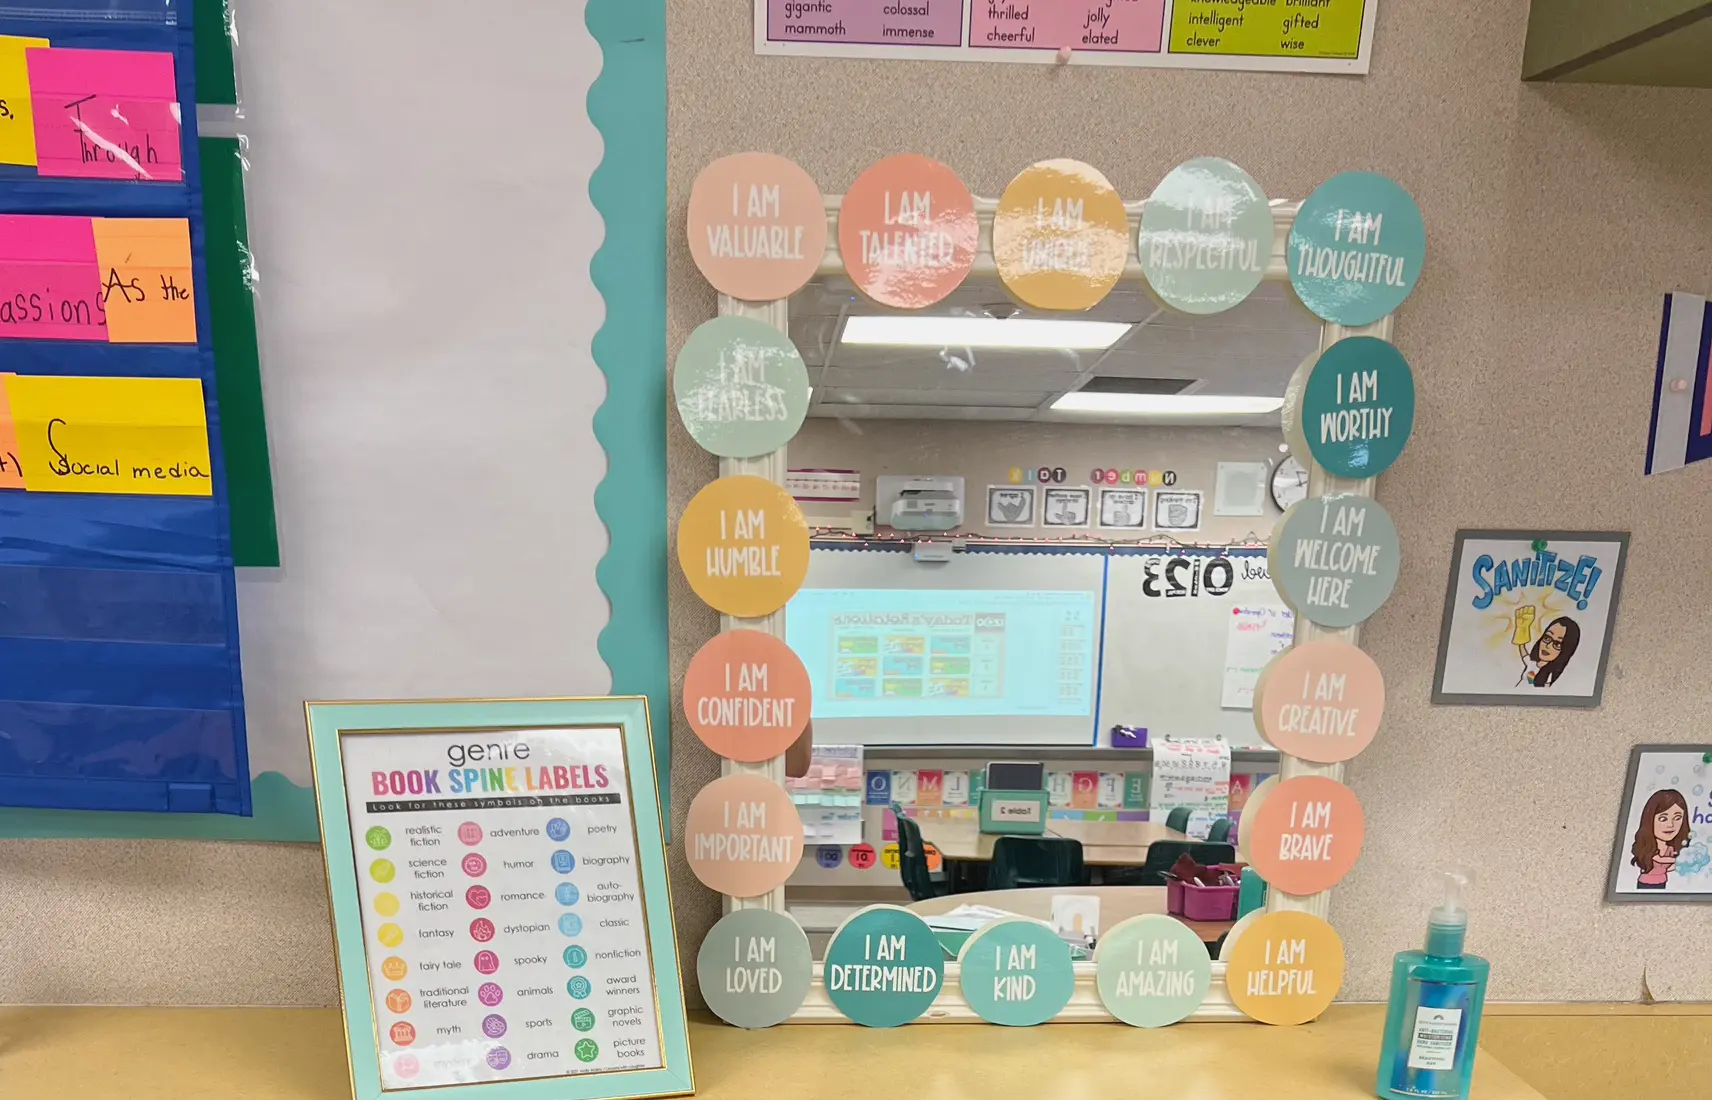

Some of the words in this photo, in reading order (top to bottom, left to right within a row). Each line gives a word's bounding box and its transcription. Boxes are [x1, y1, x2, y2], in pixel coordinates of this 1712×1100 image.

[785, 1, 832, 19] gigantic
[883, 4, 929, 16] colossal
[988, 5, 1028, 20] thrilled
[1084, 9, 1110, 28] jolly
[1188, 12, 1244, 31] intelligent
[1282, 12, 1319, 35] gifted
[785, 20, 846, 36] mammoth
[882, 25, 934, 39] immense
[987, 28, 1034, 43] cheerful
[1082, 30, 1118, 44] elated
[1186, 36, 1220, 47] clever
[1280, 39, 1304, 49] wise
[732, 183, 738, 216] I
[747, 185, 779, 217] AM
[885, 191, 890, 225] I
[898, 191, 931, 225] AM
[1334, 209, 1341, 241] I
[1350, 212, 1382, 246] AM
[707, 225, 804, 259] VALUABLE
[860, 230, 955, 266] TALENTED
[1298, 246, 1405, 287] THOUGHTFUL
[102, 268, 145, 303] As
[161, 275, 189, 301] the
[1336, 374, 1341, 404] I
[1349, 370, 1378, 402] AM
[1320, 408, 1393, 444] WORTHY
[133, 462, 210, 479] media
[721, 510, 726, 540] I
[735, 509, 764, 540] AM
[1321, 505, 1329, 533] I
[1333, 506, 1366, 536] AM
[706, 546, 781, 577] HUMBLE
[1294, 539, 1381, 576] WELCOME
[1472, 550, 1602, 610] SANITIZE!
[1307, 576, 1353, 609] HERE
[725, 663, 730, 692] I
[739, 663, 767, 692] AM
[1302, 672, 1310, 700] I
[1315, 673, 1346, 701] AM
[697, 697, 795, 727] CONFIDENT
[1278, 704, 1359, 736] CREATIVE
[447, 743, 530, 767] genre
[371, 769, 442, 796] BOOK
[448, 766, 519, 794] SPINE
[525, 764, 609, 791] LABELS
[373, 803, 401, 811] Look
[474, 798, 522, 808] symbols
[576, 796, 610, 804] books
[724, 801, 729, 828] I
[737, 802, 766, 829] AM
[1290, 802, 1296, 827] I
[1301, 801, 1331, 828] AM
[405, 825, 442, 835] realistic
[490, 827, 539, 838] adventure
[588, 823, 617, 834] poetry
[410, 837, 440, 847] fiction
[694, 833, 794, 864] IMPORTANT
[1279, 833, 1332, 861] BRAVE
[408, 858, 447, 868] science
[503, 859, 534, 869] humor
[582, 854, 630, 866] biography
[414, 869, 444, 879] fiction
[410, 889, 453, 900] historical
[597, 882, 622, 891] auto-
[501, 891, 544, 901] romance
[587, 891, 634, 903] biography
[418, 902, 448, 912] fiction
[504, 922, 550, 934] dystopian
[599, 917, 629, 927] classic
[418, 928, 454, 939] fantasy
[595, 948, 641, 959] nonfiction
[735, 937, 739, 962] I
[747, 937, 775, 963] AM
[865, 934, 870, 960] I
[877, 935, 905, 960] AM
[1138, 940, 1143, 965] I
[1150, 939, 1178, 965] AM
[1265, 939, 1271, 965] I
[1276, 939, 1306, 964] AM
[419, 960, 439, 971] fairy
[442, 960, 461, 969] tale
[514, 955, 548, 966] spooky
[995, 946, 1000, 971] I
[1008, 944, 1036, 970] AM
[606, 975, 636, 984] award
[726, 967, 782, 993] LOVED
[831, 964, 936, 992] DETERMINED
[1116, 971, 1194, 997] AMAZING
[1247, 971, 1317, 996] HELPFUL
[420, 986, 469, 997] traditional
[517, 986, 553, 996] animals
[606, 986, 640, 995] winners
[993, 975, 1036, 1001] KIND
[423, 998, 467, 1009] literature
[608, 1005, 643, 1017] graphic
[436, 1024, 461, 1035] myth
[525, 1018, 552, 1028] sports
[612, 1017, 642, 1027] novels
[613, 1037, 645, 1048] picture
[527, 1050, 559, 1059] drama
[617, 1048, 644, 1058] books
